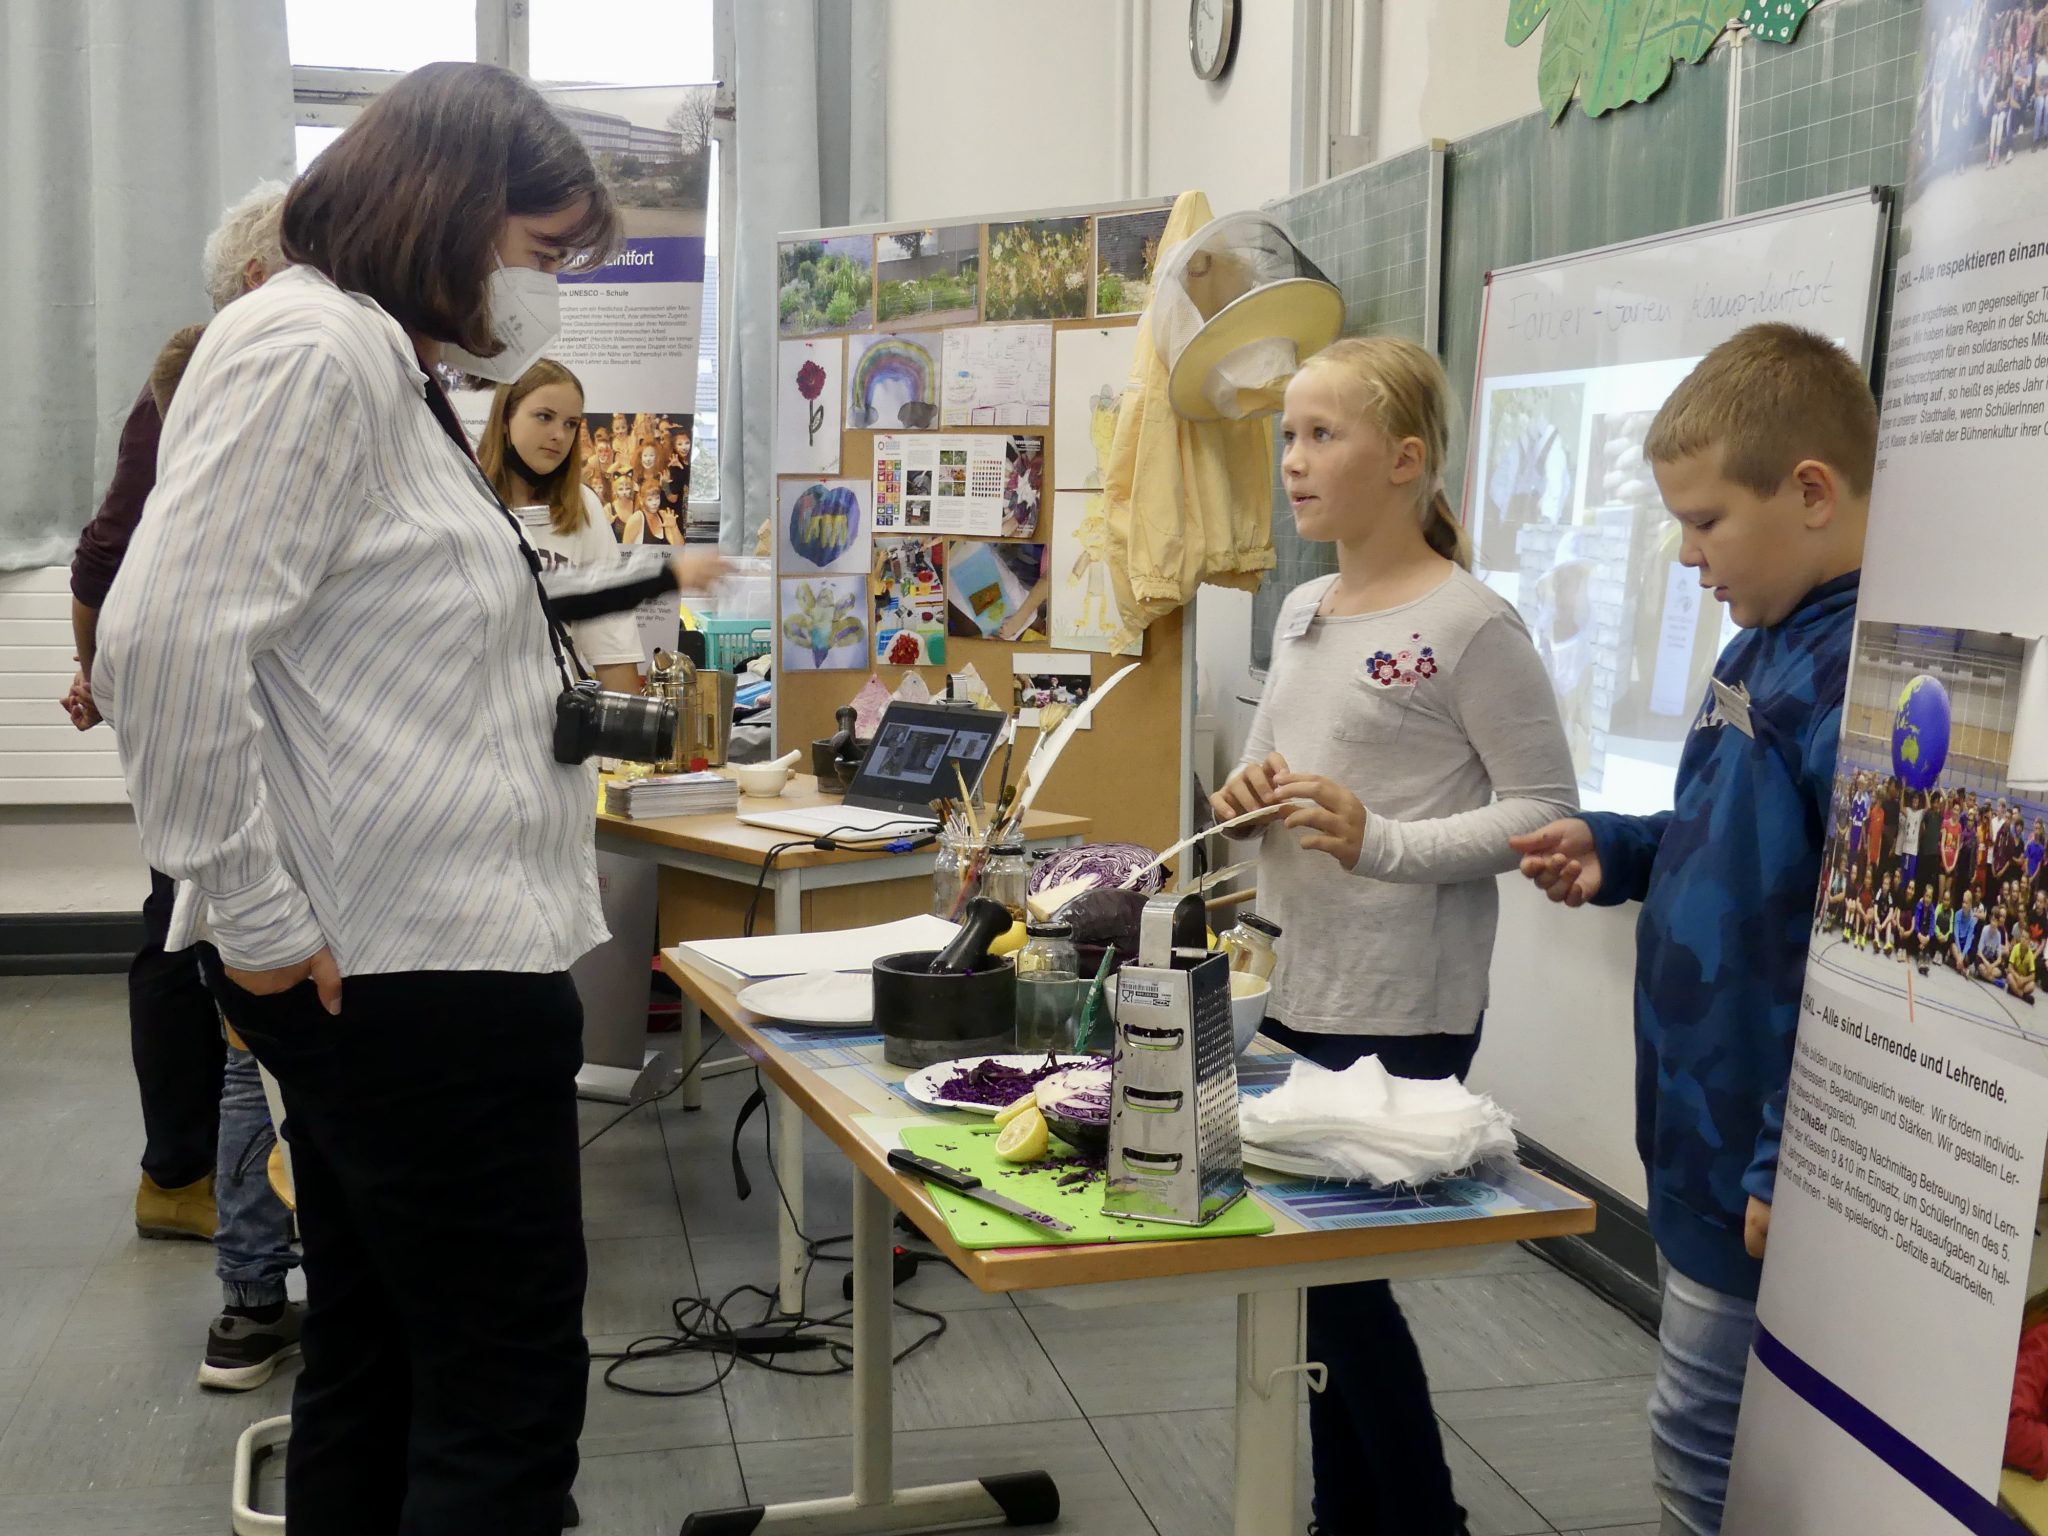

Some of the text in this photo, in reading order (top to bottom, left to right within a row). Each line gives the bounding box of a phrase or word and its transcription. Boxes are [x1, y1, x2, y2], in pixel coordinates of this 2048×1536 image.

[1936, 250, 2006, 279] respektieren
[606, 289, 629, 297] Schule
[1962, 302, 1976, 314] von
[1978, 290, 2039, 314] gegenseitiger
[1946, 322, 1964, 337] klare
[1966, 317, 1996, 336] Regeln
[1998, 315, 2006, 329] in
[2008, 313, 2024, 327] der
[1946, 344, 1956, 358] für
[1958, 343, 1970, 357] ein
[1972, 336, 2028, 355] solidarisches
[1958, 364, 1966, 378] in
[1968, 361, 1984, 376] und
[1986, 356, 2032, 374] außerhalb
[1948, 388, 1958, 400] so
[1960, 382, 1981, 398] heißt
[1983, 385, 1994, 396] es
[1995, 380, 2020, 398] jedes
[2022, 378, 2042, 392] Jahr
[1920, 406, 1958, 424] Stadthalle,
[1960, 406, 1982, 420] wenn
[1985, 401, 2044, 418] SchülerInnen
[1920, 428, 1943, 444] Vielfalt
[1945, 428, 1958, 442] der
[1960, 422, 2018, 441] Bühnenkultur
[2020, 422, 2042, 436] ihrer
[1822, 1006, 1838, 1028] Alle
[1841, 1017, 1862, 1040] sind
[1864, 1025, 1917, 1062] Lernende
[1920, 1053, 1944, 1074] und
[1946, 1060, 2007, 1104] Lehrende.
[1829, 1060, 1842, 1076] uns
[1843, 1064, 1896, 1102] kontinuierlich
[1898, 1093, 1925, 1116] weiter.
[1932, 1104, 1946, 1125] Wir
[1948, 1114, 1982, 1142] fördern
[1984, 1130, 2024, 1162] individu-
[1830, 1080, 1878, 1117] Begabungen
[1880, 1108, 1896, 1126] und
[1898, 1114, 1934, 1145] Stärken.
[1937, 1132, 1954, 1154] Wir
[1954, 1144, 1998, 1176] gestalten
[2000, 1164, 2020, 1186] Ler-
[1804, 1133, 1830, 1160] Klassen
[1856, 1164, 1866, 1181] im
[1868, 1170, 1900, 1202] Einsatz,
[1904, 1192, 1918, 1209] um
[1982, 1234, 1999, 1256] des
[1830, 1126, 1868, 1162] (Dienstag
[1870, 1146, 1918, 1188] Nachmittag
[1920, 1172, 1970, 1216] Betreuung)
[1972, 1203, 1992, 1225] sind
[1994, 1212, 2020, 1240] Lern-
[1818, 1164, 1830, 1183] bei
[1830, 1172, 1844, 1190] der
[1844, 1180, 1892, 1222] Anfertigung
[1894, 1208, 1908, 1226] der
[1910, 1218, 1976, 1268] Hausaufgaben
[1977, 1258, 1990, 1276] zu
[1992, 1264, 2010, 1286] hel-
[1827, 1194, 1843, 1215] teils
[1845, 1203, 1888, 1242] spielerisch
[1896, 1232, 1928, 1264] Defizite
[1930, 1256, 1994, 1306] aufzuarbeiten.
